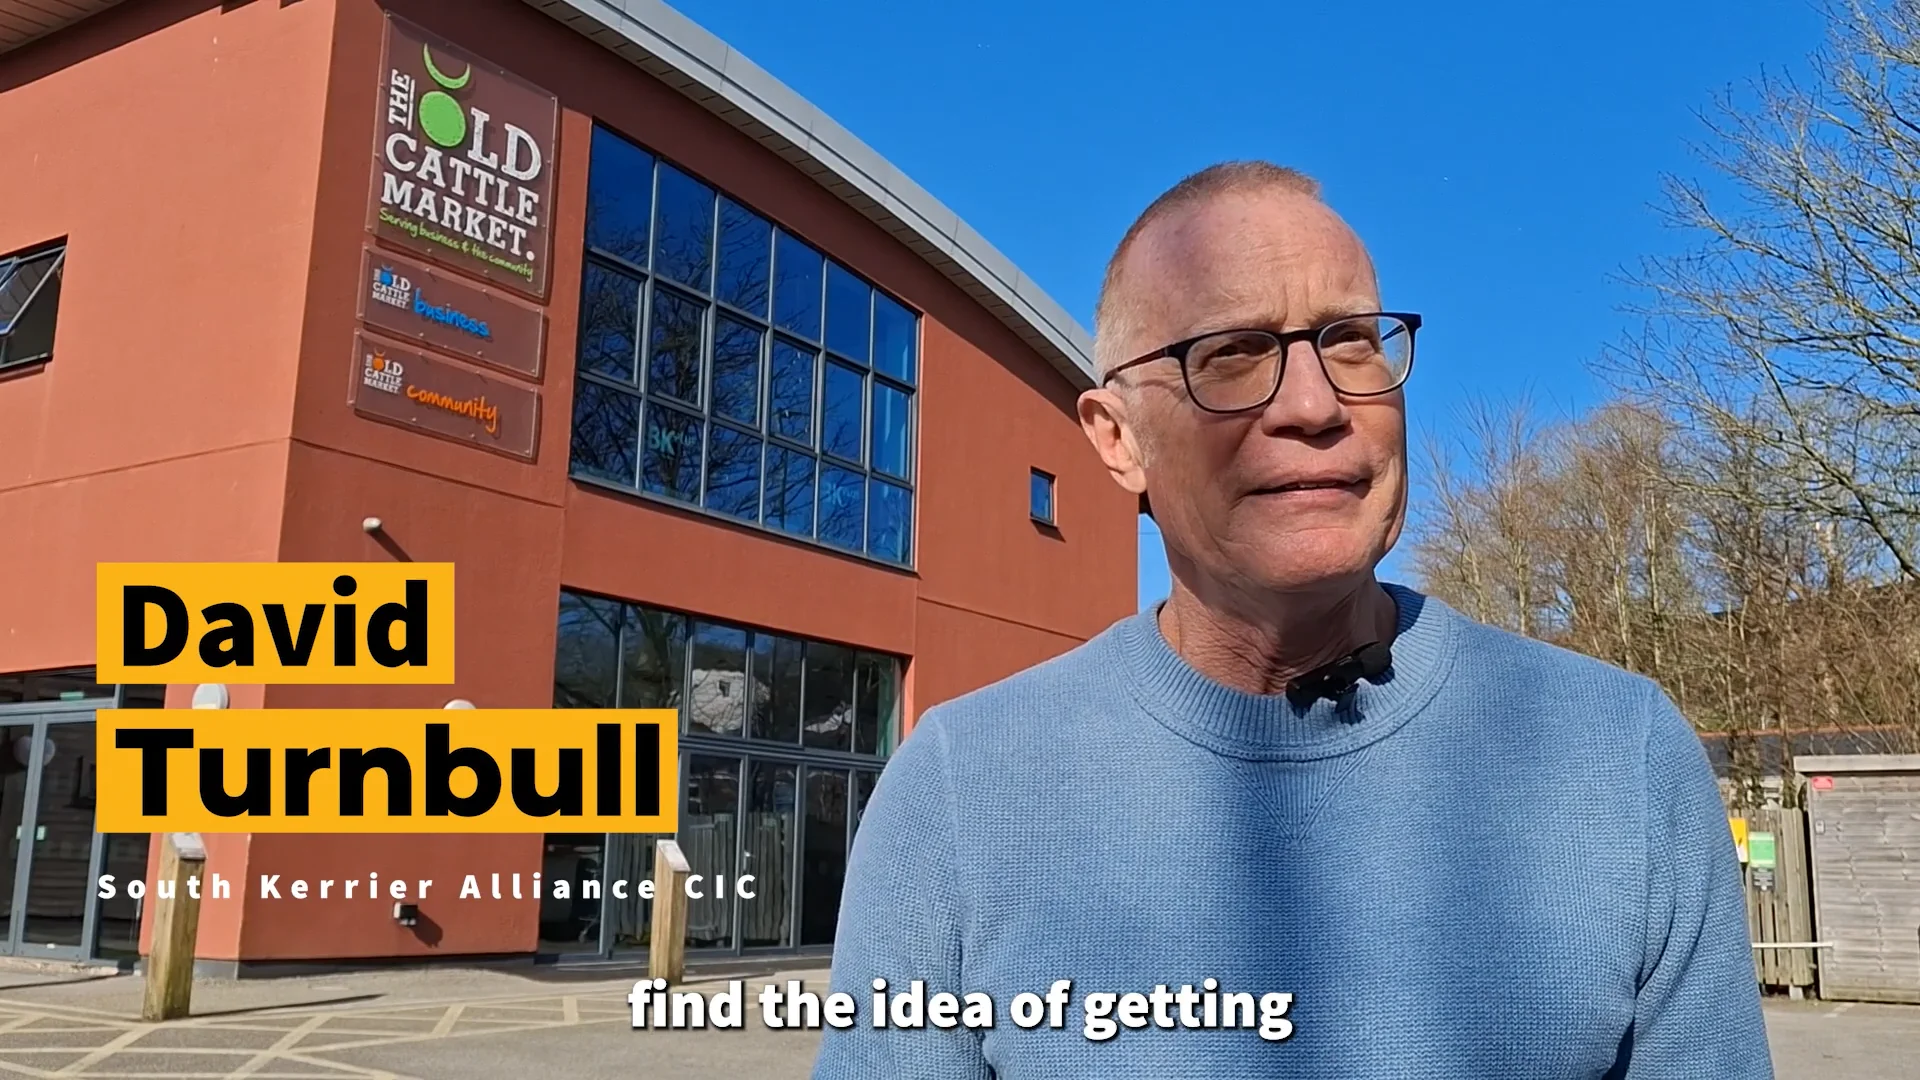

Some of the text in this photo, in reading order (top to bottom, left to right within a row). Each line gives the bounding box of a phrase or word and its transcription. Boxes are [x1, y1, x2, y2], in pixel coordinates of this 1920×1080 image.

[388, 69, 411, 127] THE
[385, 132, 539, 227] CATTLE
[381, 172, 536, 262] MARKET.
[379, 207, 418, 238] Serving
[419, 222, 460, 250] business
[472, 243, 489, 261] the
[488, 253, 533, 283] community
[372, 281, 411, 302] CATTLE
[413, 287, 491, 338] business
[364, 367, 403, 388] CATTLE
[406, 384, 498, 432] community
